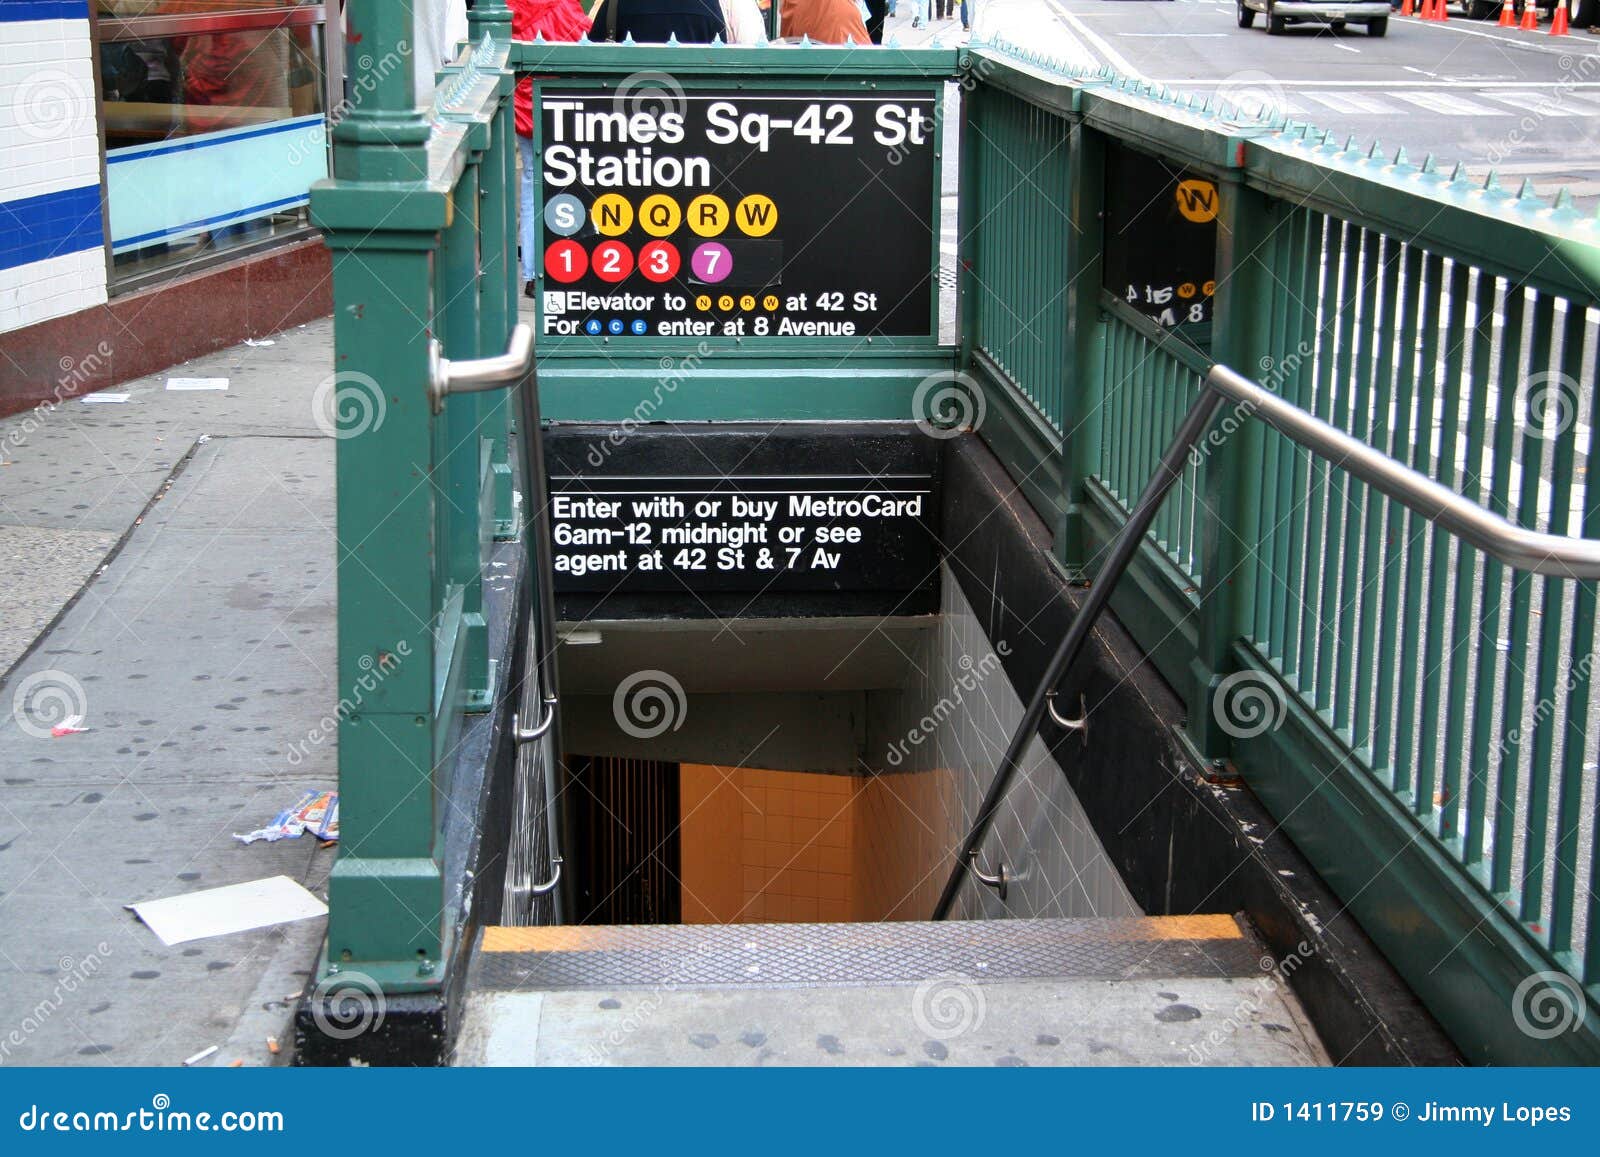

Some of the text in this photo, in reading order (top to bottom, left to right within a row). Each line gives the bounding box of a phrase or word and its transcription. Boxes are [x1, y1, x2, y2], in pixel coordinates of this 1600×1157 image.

[542, 101, 925, 153] Times Sq-42 St
[543, 145, 711, 188] Station
[566, 291, 655, 311] Elevator
[663, 293, 687, 312] to
[785, 293, 808, 312] at
[815, 292, 845, 311] 42
[852, 292, 878, 312] St
[543, 316, 579, 336] For
[657, 318, 715, 336] enter
[723, 318, 745, 337] at
[753, 317, 770, 336] 8
[777, 317, 856, 337] Avenue
[553, 495, 922, 522] Enter with or buy MetroCard
[554, 521, 862, 548] 6am-12 midnight or see
[554, 546, 841, 576] agent at 42 St & 7 Av
